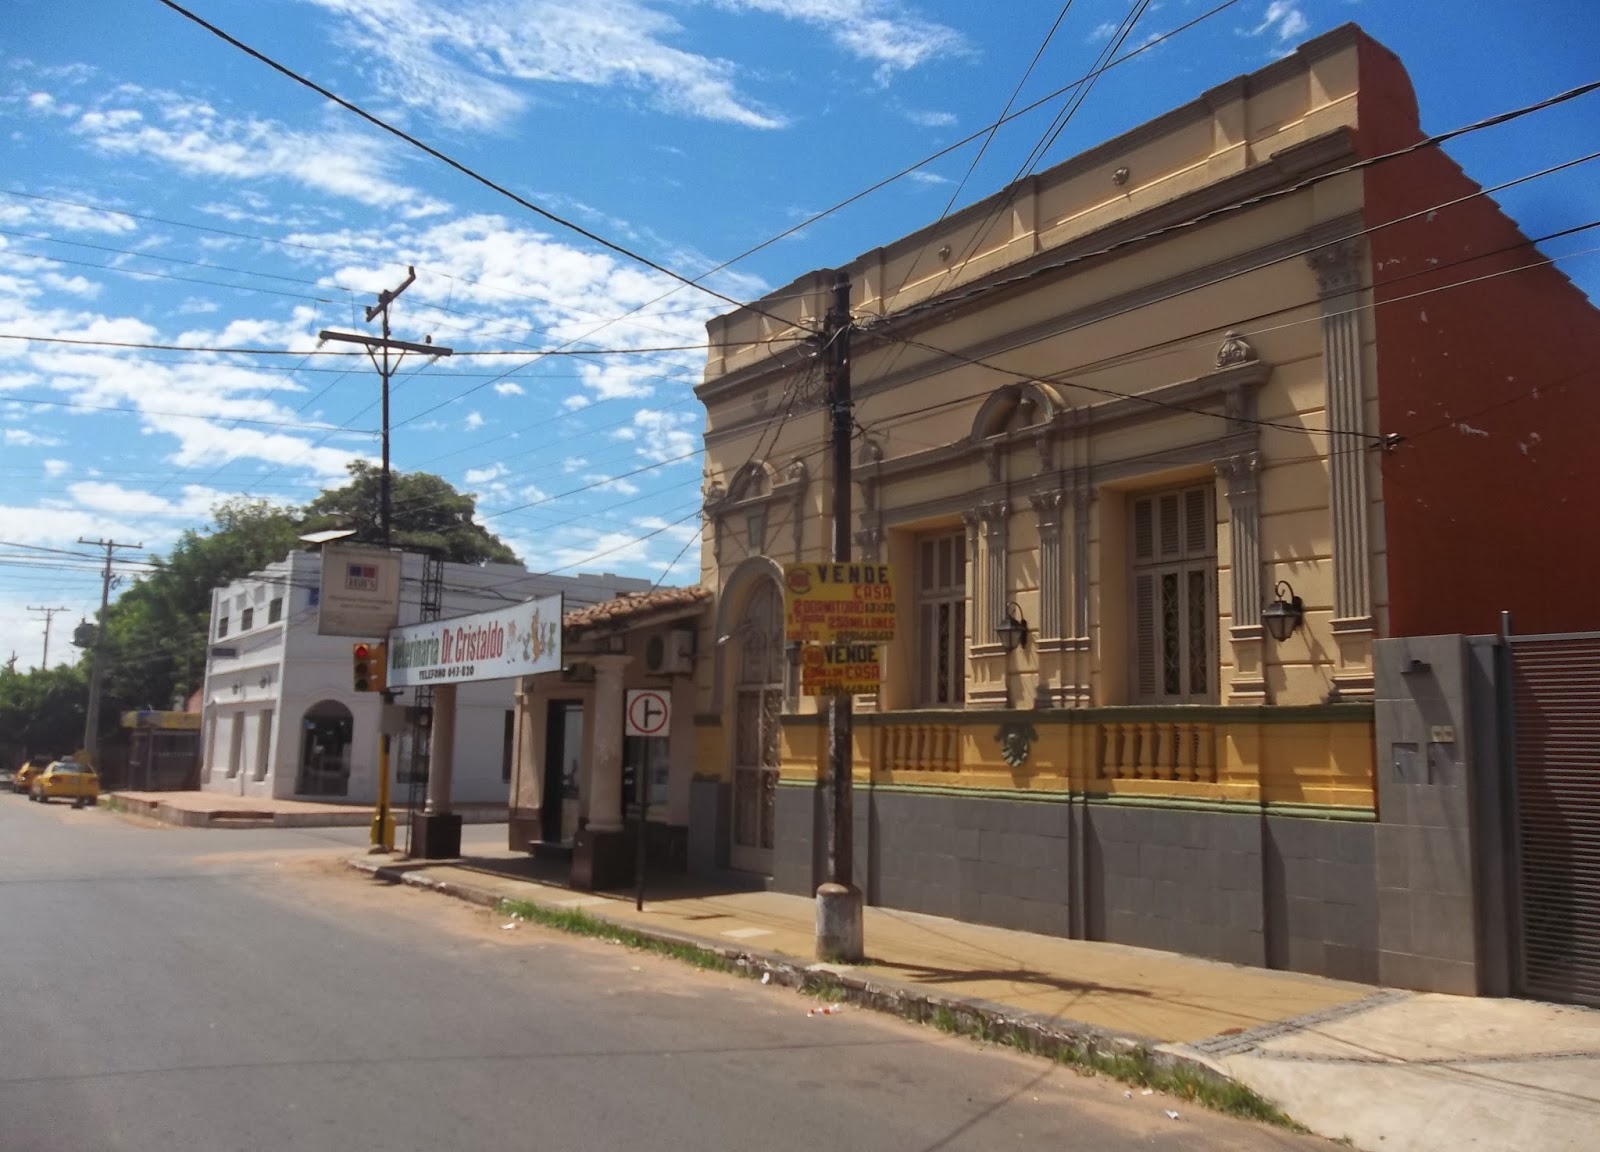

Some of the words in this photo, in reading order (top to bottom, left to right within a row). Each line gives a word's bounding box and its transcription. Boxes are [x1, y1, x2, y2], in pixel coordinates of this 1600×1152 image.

[818, 565, 889, 584] VENDE
[854, 585, 892, 599] CASA
[455, 620, 504, 664] Cristaldo
[825, 645, 878, 664] VENDE
[846, 665, 881, 681] CASA
